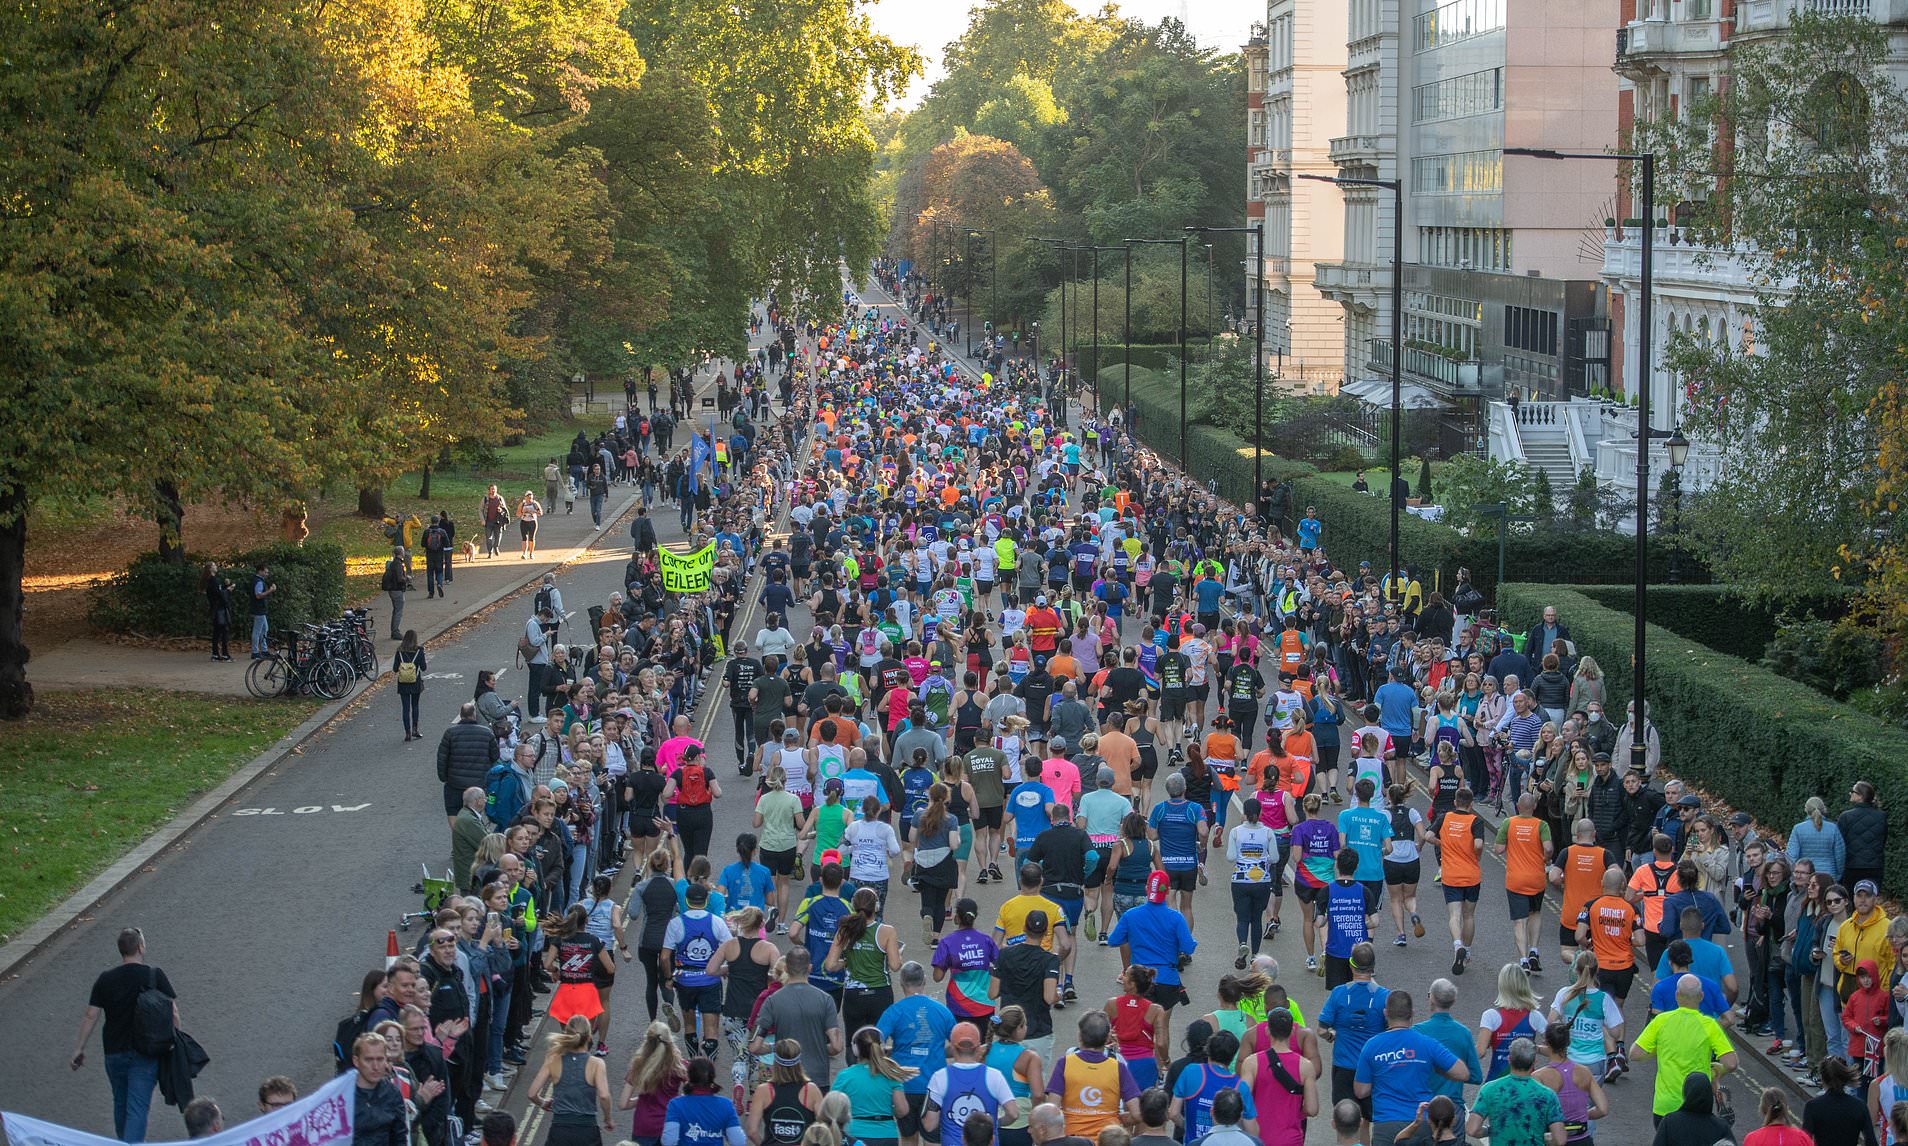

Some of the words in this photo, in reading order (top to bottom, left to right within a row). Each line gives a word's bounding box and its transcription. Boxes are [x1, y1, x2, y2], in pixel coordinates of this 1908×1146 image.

[662, 554, 695, 570] come
[699, 550, 713, 565] on
[971, 757, 994, 765] ROYAL
[232, 803, 372, 817] SLOW
[1600, 907, 1625, 919] PUTNEY
[1604, 925, 1620, 936] CLUB
[959, 949, 985, 961] MILE
[1374, 1047, 1415, 1062] mnda
